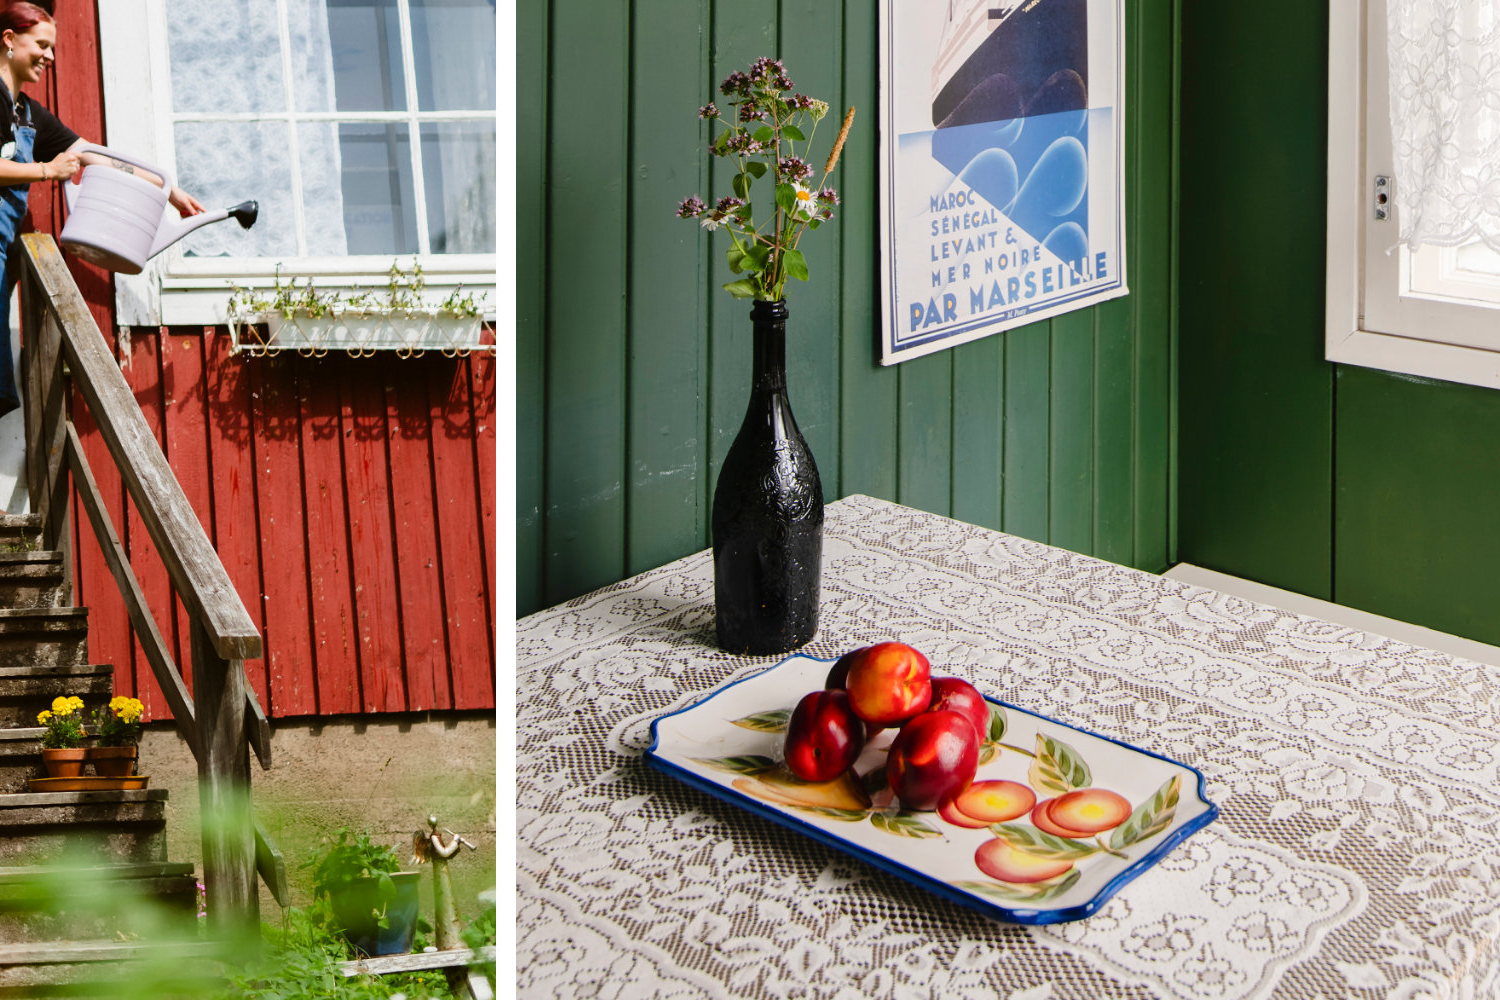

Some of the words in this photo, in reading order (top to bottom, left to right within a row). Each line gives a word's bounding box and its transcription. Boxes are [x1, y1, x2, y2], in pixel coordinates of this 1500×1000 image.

[930, 188, 975, 213] MAROC
[931, 208, 998, 236] SÉNÉGAL
[931, 231, 997, 262] LEVANT
[1005, 227, 1018, 244] &
[932, 263, 970, 288] MER
[985, 245, 1041, 274] NOIRE
[910, 292, 958, 332] PAR
[970, 251, 1107, 315] MARSEILLE
